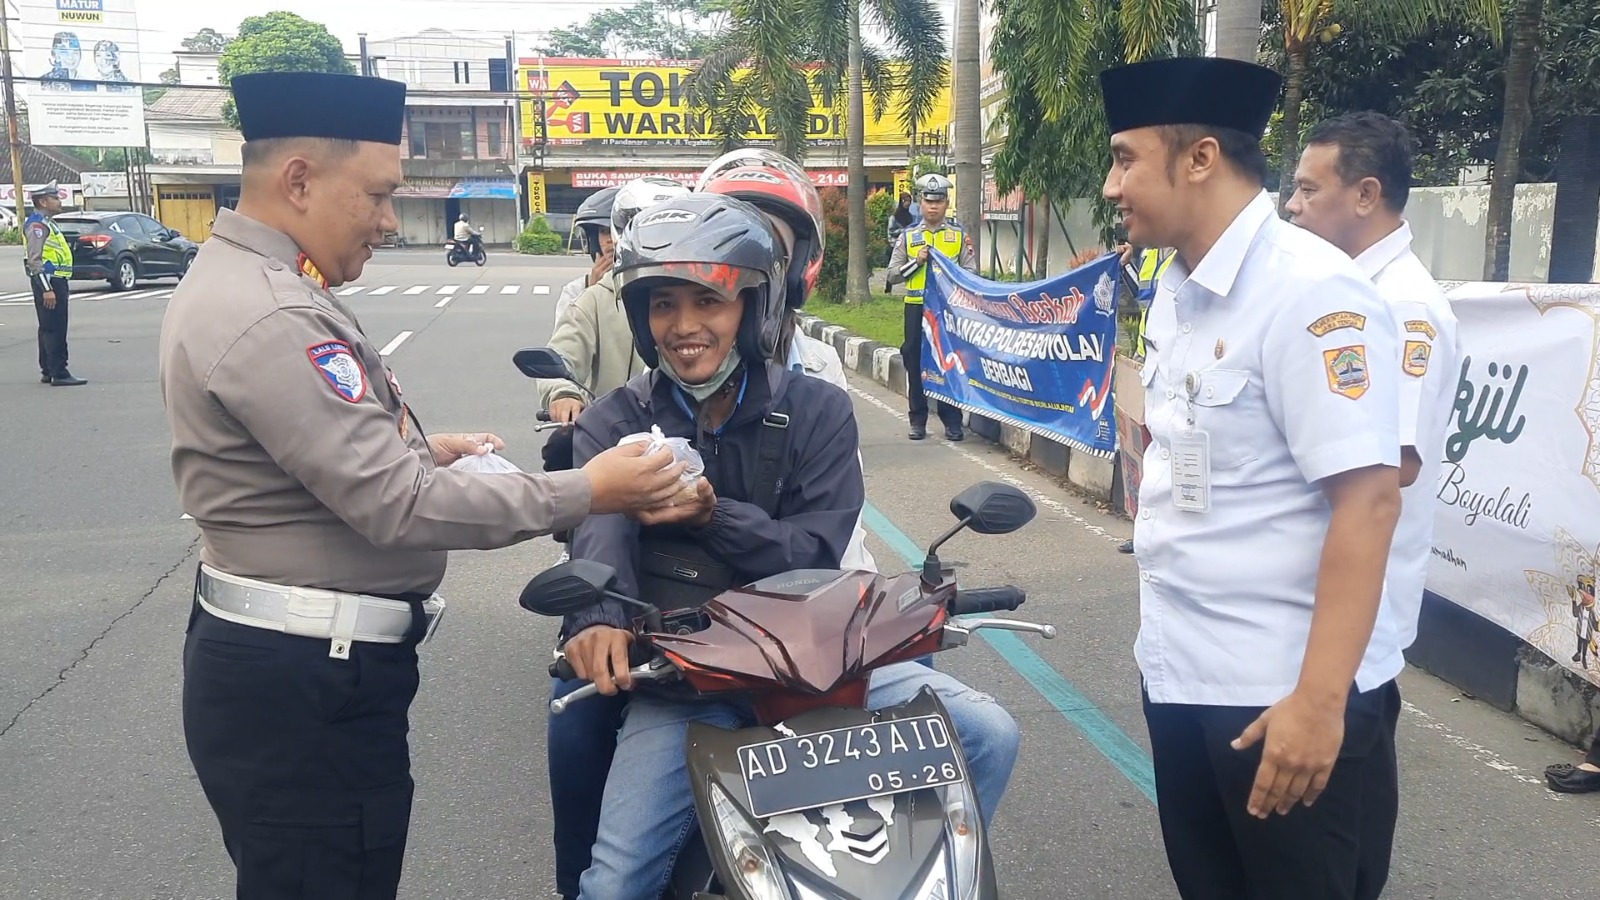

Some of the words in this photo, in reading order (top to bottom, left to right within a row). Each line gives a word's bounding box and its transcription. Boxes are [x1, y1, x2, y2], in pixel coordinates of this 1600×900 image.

[60, 0, 99, 9] MATUR
[61, 12, 99, 20] NUWUN
[572, 113, 582, 132] WA
[576, 180, 615, 188] SEMUA
[731, 174, 774, 182] INK
[641, 213, 693, 225] INK
[991, 325, 1034, 359] POLRES
[980, 357, 1034, 392] BERBAGI
[1437, 460, 1531, 529] Boyolali
[776, 578, 820, 589] HONDA
[748, 743, 787, 780] AD
[797, 727, 881, 768] 3243
[890, 717, 949, 753] AID
